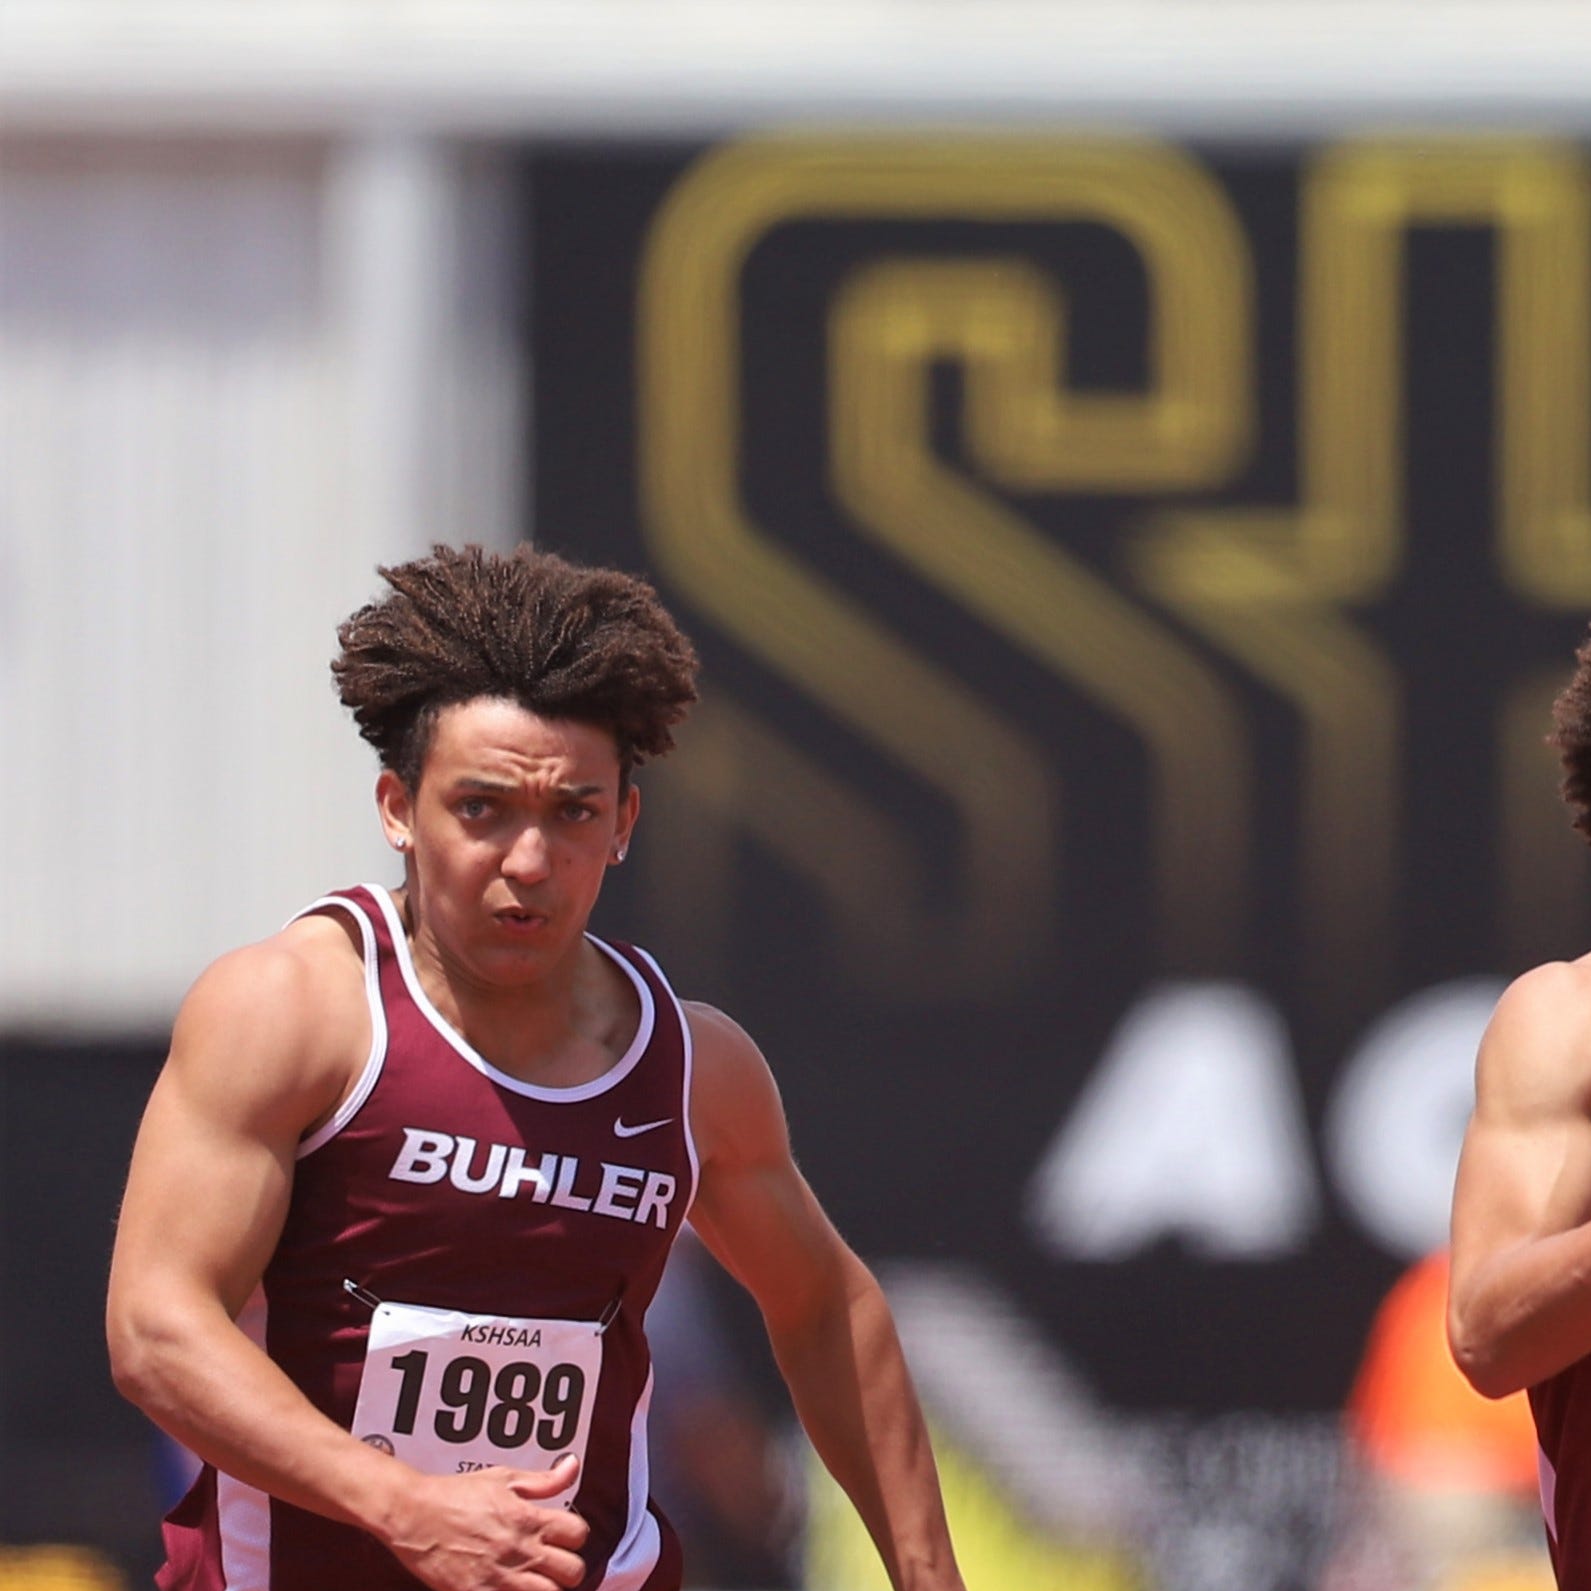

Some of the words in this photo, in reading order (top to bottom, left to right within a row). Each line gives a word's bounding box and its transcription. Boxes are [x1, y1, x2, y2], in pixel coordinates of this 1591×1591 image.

[388, 1127, 676, 1230] BUHLER
[460, 1323, 542, 1349] KSHSAA
[390, 1349, 585, 1452] 1989
[456, 1460, 500, 1474] STA
